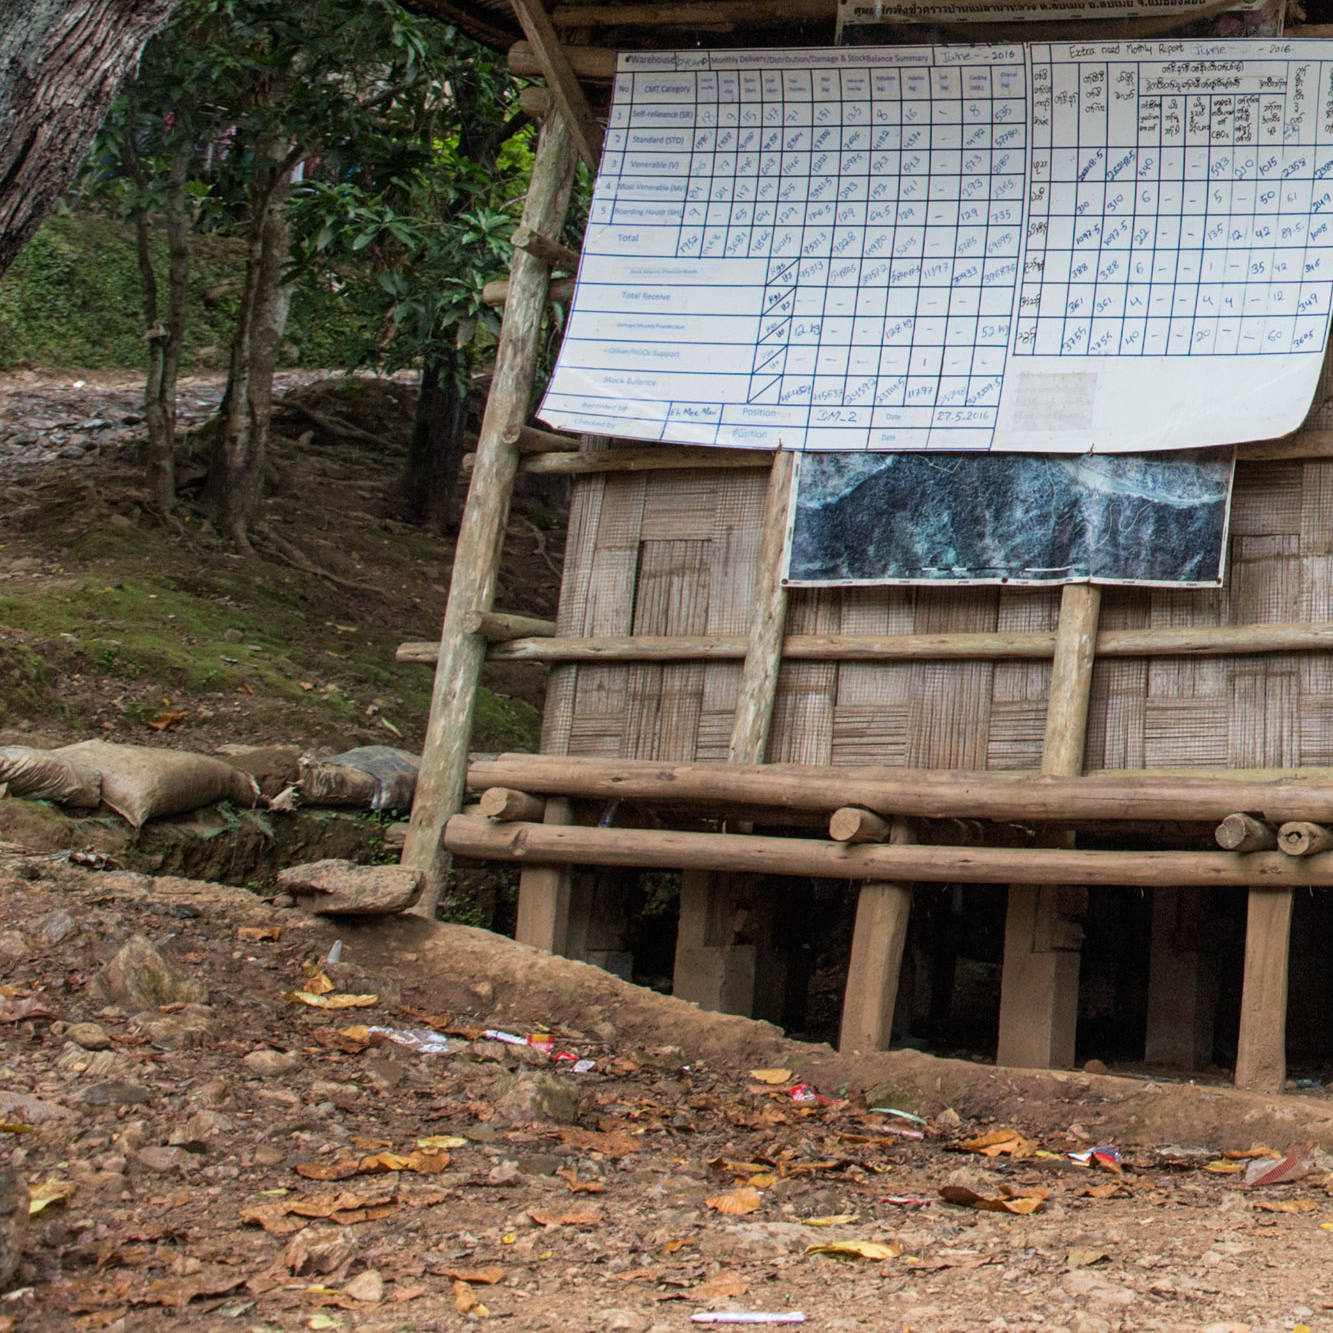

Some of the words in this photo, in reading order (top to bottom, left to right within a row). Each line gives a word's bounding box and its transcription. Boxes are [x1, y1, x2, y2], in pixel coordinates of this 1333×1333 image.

[992, 50, 1015, 60] 2016
[1069, 46, 1095, 58] Extra
[1270, 45, 1292, 53] 2016
[632, 55, 675, 64] Warehouse
[711, 56, 738, 64] Monthly
[896, 54, 929, 63] Summary
[661, 85, 691, 94] Category
[680, 110, 693, 119] (SR)
[764, 106, 779, 122] 47
[786, 109, 799, 122] 71
[816, 107, 831, 122] 151
[876, 108, 889, 122] 8
[905, 108, 918, 121] 16
[969, 104, 981, 117] 8
[632, 135, 664, 144] Standard
[665, 135, 684, 145] (STD)
[668, 160, 680, 170] (V)
[903, 155, 921, 174] 543
[964, 154, 983, 172] 573
[1138, 157, 1154, 177] 540
[1210, 156, 1230, 178] 593
[1258, 156, 1278, 176] 1015
[1281, 157, 1307, 178] 2358
[779, 182, 796, 200] 305
[961, 178, 984, 197] 293
[1076, 200, 1090, 215] 310
[1106, 193, 1124, 212] 310
[1141, 190, 1151, 203] 6
[1213, 189, 1223, 203] 5
[1259, 190, 1276, 205] 50
[1286, 192, 1298, 203] 61
[1312, 192, 1331, 214] 249
[837, 207, 856, 222] 129
[898, 207, 915, 221] 129
[960, 207, 979, 221] 129
[990, 208, 1012, 222] 735
[617, 233, 639, 242] Total
[1134, 227, 1150, 246] 22
[1255, 225, 1271, 239] 42
[1309, 222, 1328, 242] 1008
[831, 231, 857, 254] 9228
[1071, 262, 1089, 279] 388
[1099, 259, 1120, 281] 388
[1135, 261, 1144, 275] 6
[1251, 261, 1265, 275] 35
[621, 291, 641, 299] Total
[642, 292, 671, 301] Receive
[1067, 297, 1084, 314] 361
[1129, 296, 1143, 306] 4
[1202, 295, 1214, 306] 4
[1224, 296, 1233, 308] 4
[1273, 290, 1284, 302] 12
[1298, 292, 1318, 312] 349
[794, 324, 808, 337] 12
[981, 325, 997, 339] 52
[1124, 330, 1140, 345] 40
[1195, 329, 1211, 343] 20
[1267, 329, 1283, 342] 60
[652, 349, 680, 358] Support
[603, 376, 625, 385] Stock
[626, 377, 657, 387] Balance
[742, 407, 776, 417] Position
[885, 413, 901, 421] Date
[732, 429, 768, 440] Position
[881, 433, 896, 442] Date
